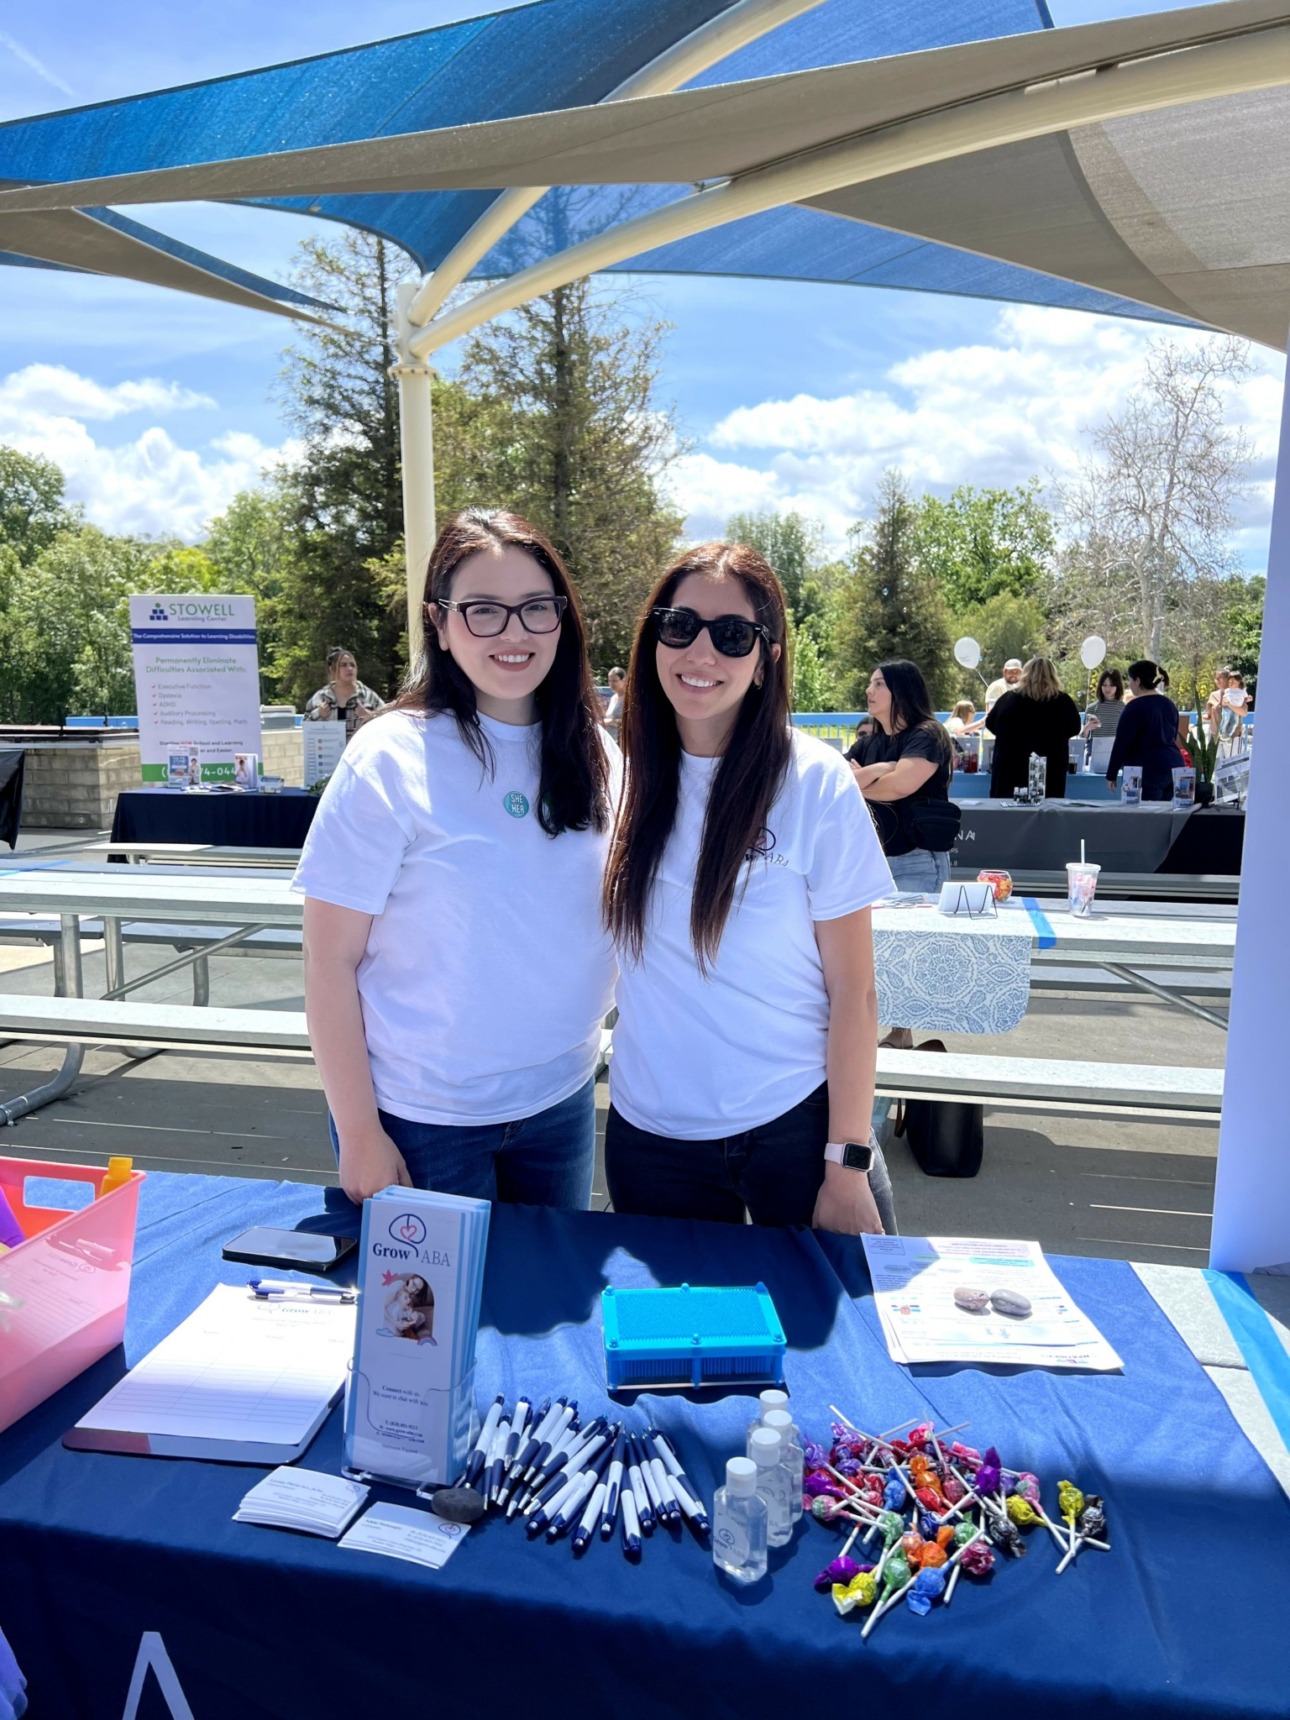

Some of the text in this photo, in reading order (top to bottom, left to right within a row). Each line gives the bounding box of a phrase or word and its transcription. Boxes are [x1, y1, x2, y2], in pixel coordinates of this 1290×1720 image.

[169, 603, 235, 616] STOWELL
[178, 615, 205, 623] Learning
[142, 633, 180, 641] Comprehensive
[207, 633, 228, 641] Learning
[155, 656, 236, 666] Permanently Eliminate
[146, 665, 185, 673] Difficulties
[511, 794, 524, 804] SHE
[511, 804, 525, 815] HER
[372, 1242, 452, 1268] Grow ABA
